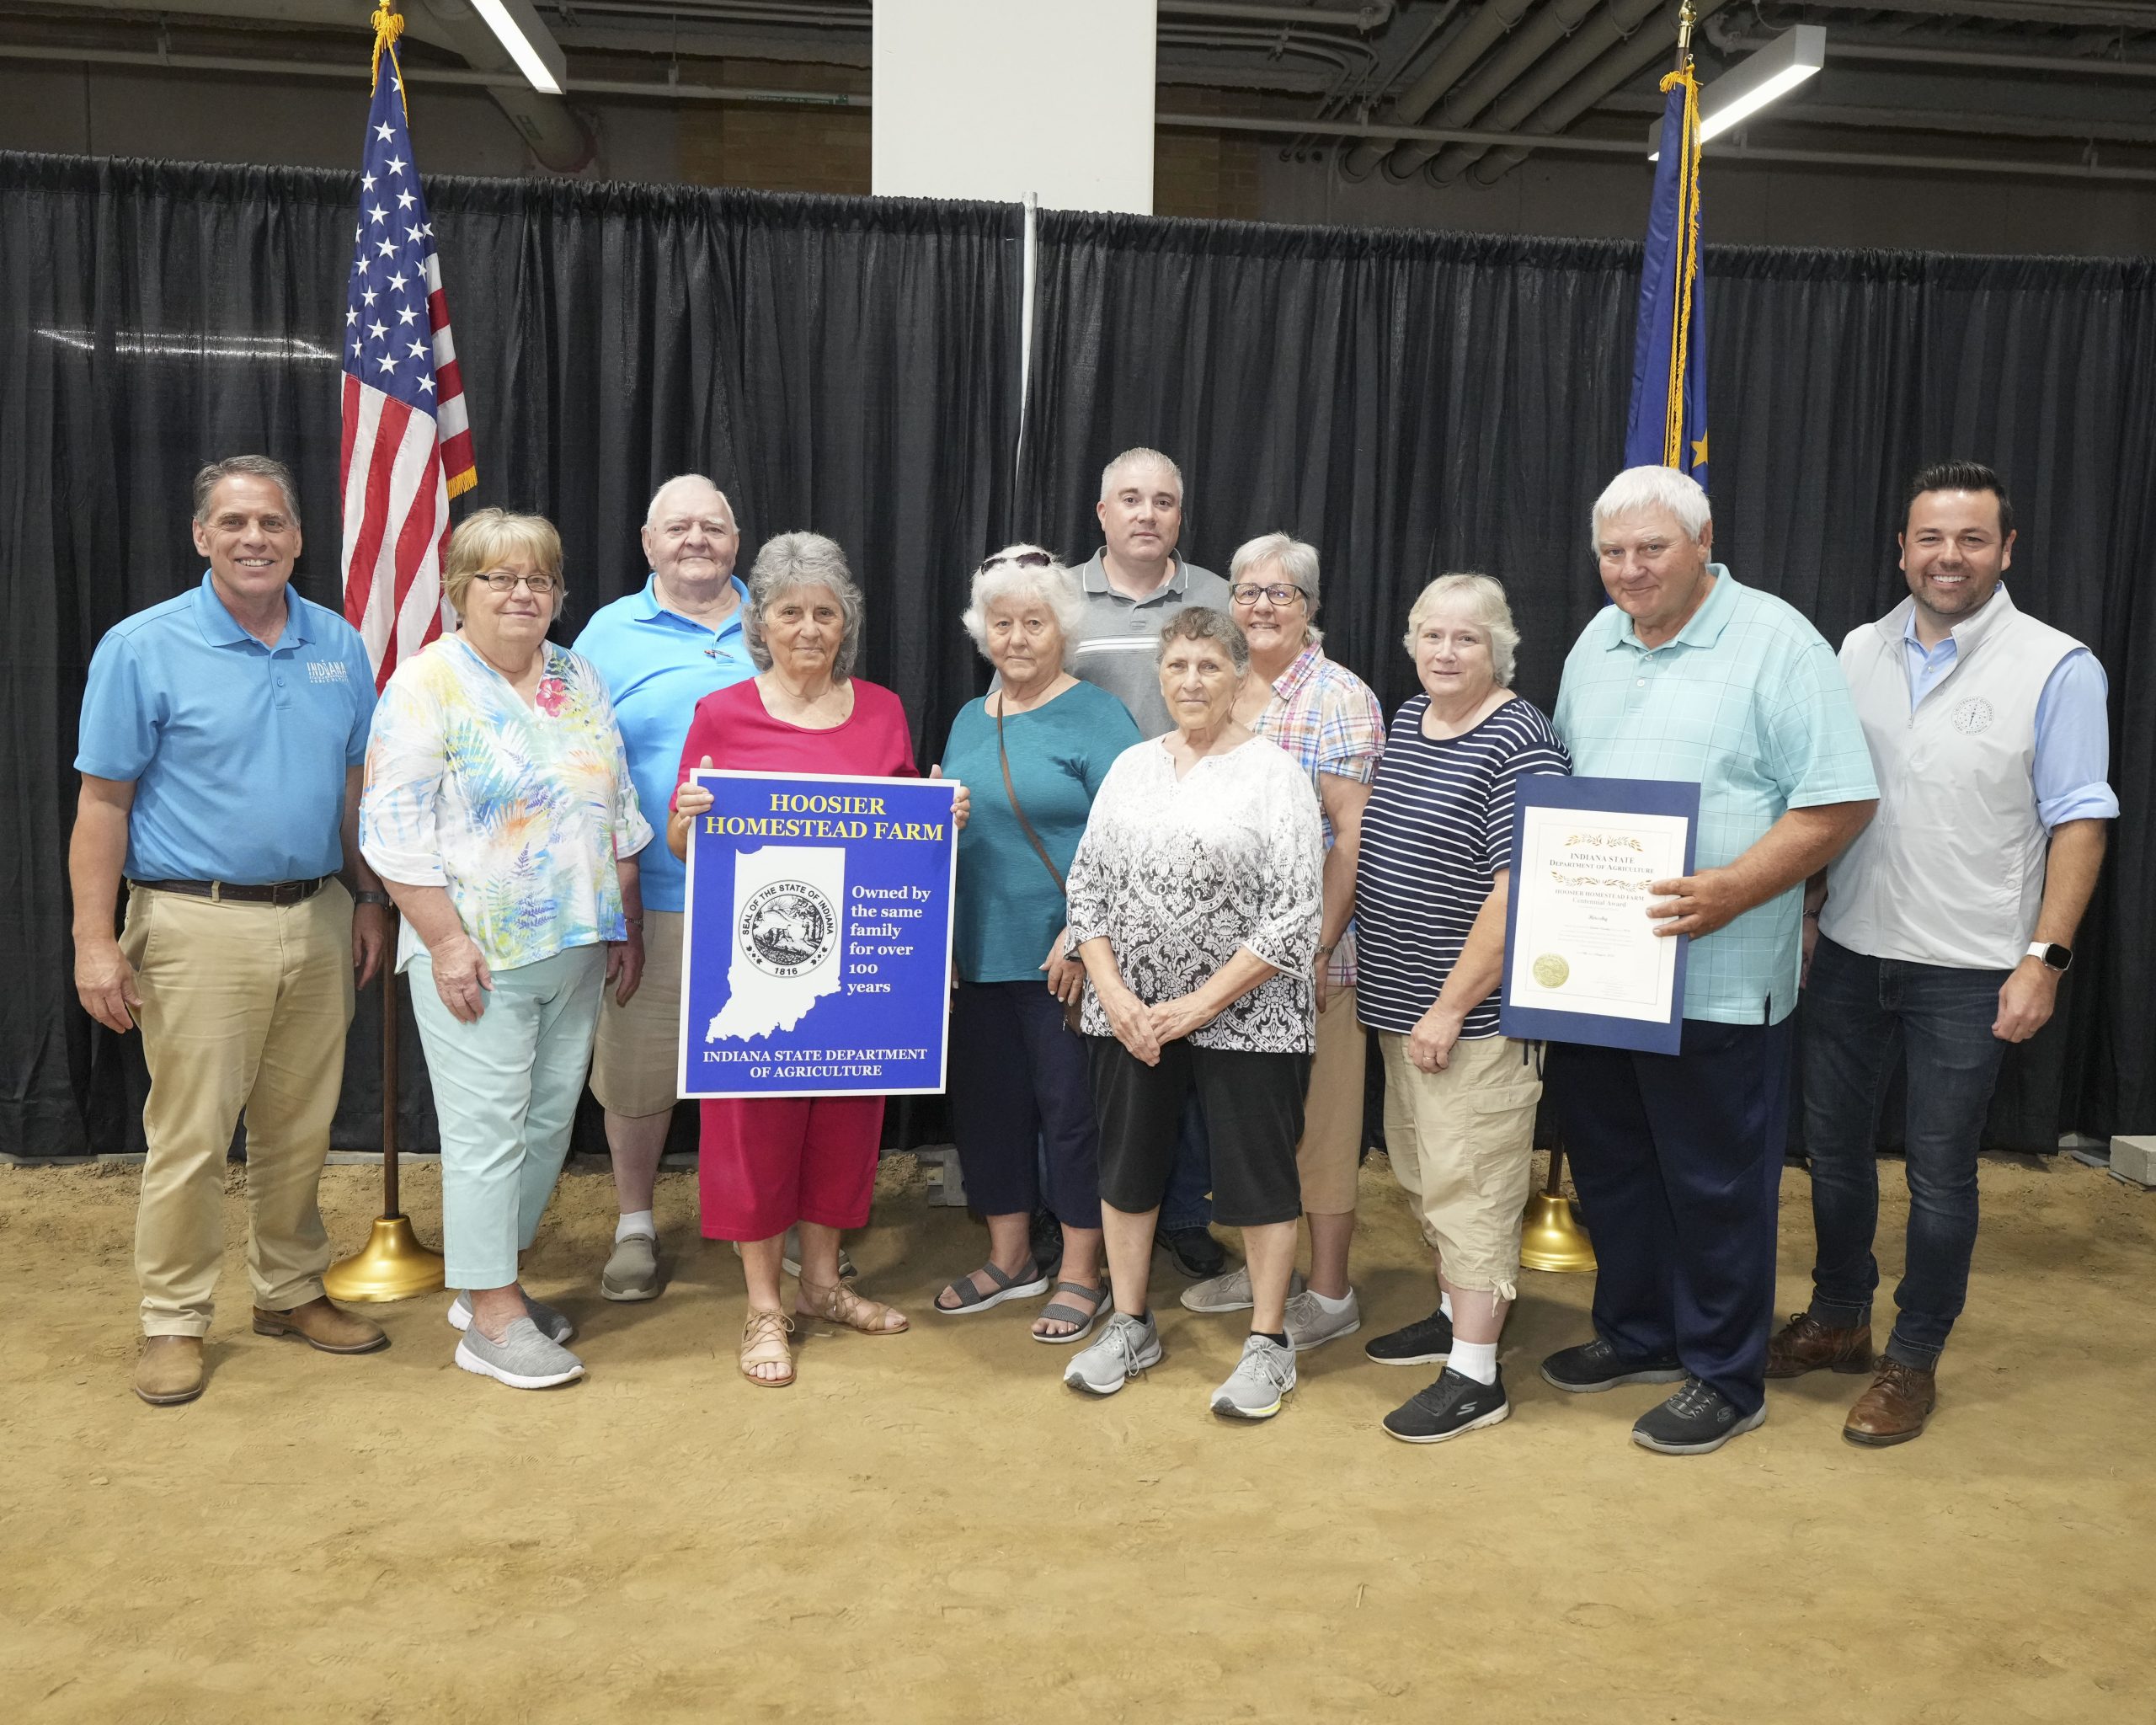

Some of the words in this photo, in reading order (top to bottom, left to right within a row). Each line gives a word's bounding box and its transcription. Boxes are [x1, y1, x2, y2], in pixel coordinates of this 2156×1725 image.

[307, 660, 346, 676] INDIANA
[770, 793, 886, 814] HOOSIER
[705, 816, 867, 838] HOMESTEAD
[873, 822, 944, 841] FARM
[1571, 852, 1607, 862] INDIANA
[1609, 856, 1635, 864] STATE
[1550, 859, 1594, 868] DEPARTMENT
[1608, 864, 1654, 874] AGRICULTURE
[851, 885, 908, 899] Owned
[912, 886, 931, 902] by
[1585, 891, 1625, 900] HOMESTEAD
[742, 914, 753, 935] SEAL
[750, 899, 760, 911] OF
[759, 887, 776, 900] THE
[779, 884, 807, 894] STATE
[808, 890, 819, 900] OF
[818, 900, 834, 935] INDIANA
[851, 904, 877, 917] the
[881, 908, 922, 918] same
[850, 923, 902, 939] family
[849, 942, 874, 955] for
[878, 945, 914, 955] over
[775, 967, 798, 975] 1816
[849, 964, 878, 974] 100
[847, 983, 891, 996] years
[702, 1051, 771, 1062] INDIANA
[774, 1050, 822, 1061] STATE
[825, 1049, 927, 1060] DEPARTMENT
[750, 1066, 771, 1078] OF
[773, 1065, 882, 1077] AGRICULTURE
